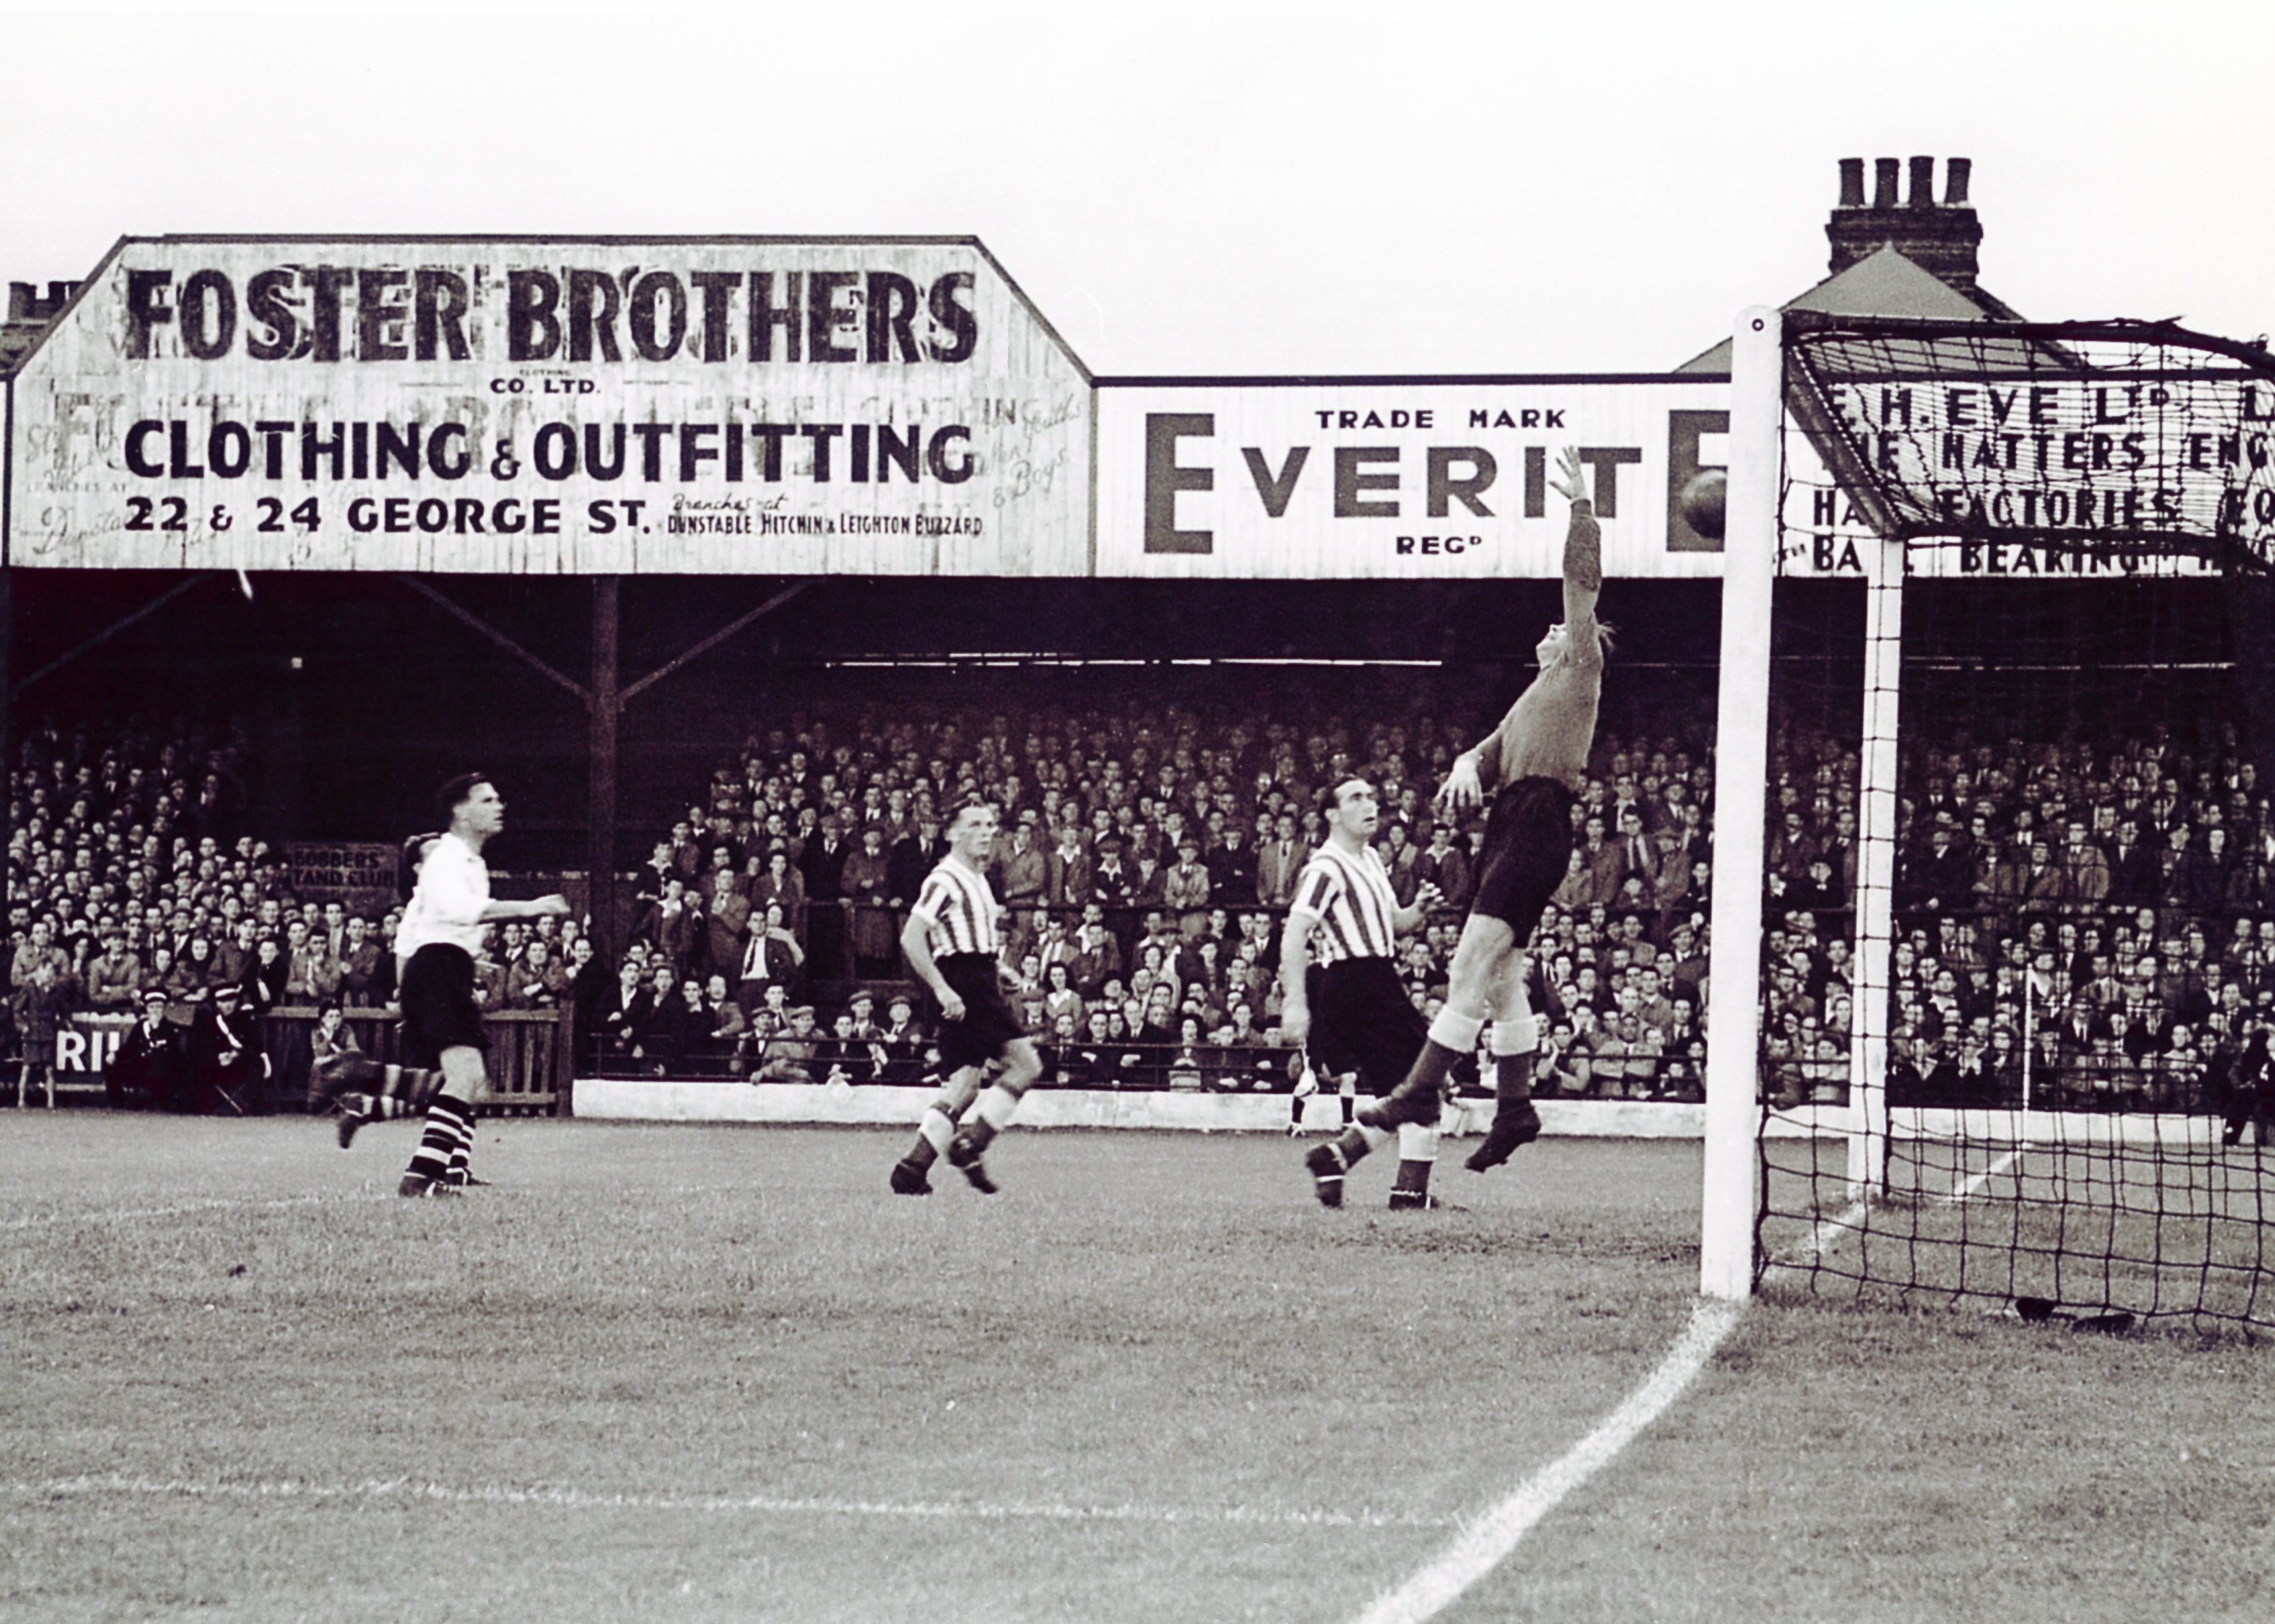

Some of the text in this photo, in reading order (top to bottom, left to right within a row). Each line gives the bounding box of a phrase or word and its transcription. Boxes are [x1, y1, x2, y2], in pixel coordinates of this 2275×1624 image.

[125, 268, 979, 364] FOSTER BROTHERS
[490, 378, 601, 394] CO. LTD.
[1315, 409, 1567, 429] TRADE MARK
[124, 419, 472, 480] CLOTHING
[490, 439, 522, 480] &
[533, 422, 975, 484] OUTFITTING
[124, 496, 188, 532] 22
[209, 504, 233, 531] &
[256, 496, 322, 533] 24
[348, 497, 561, 535] GEORGE
[588, 498, 651, 535] ST.
[667, 514, 752, 535] DUNSTABLE
[761, 512, 824, 536] HITCHIN
[840, 513, 911, 535] LEIGHTON
[915, 513, 983, 537] BUZZARD
